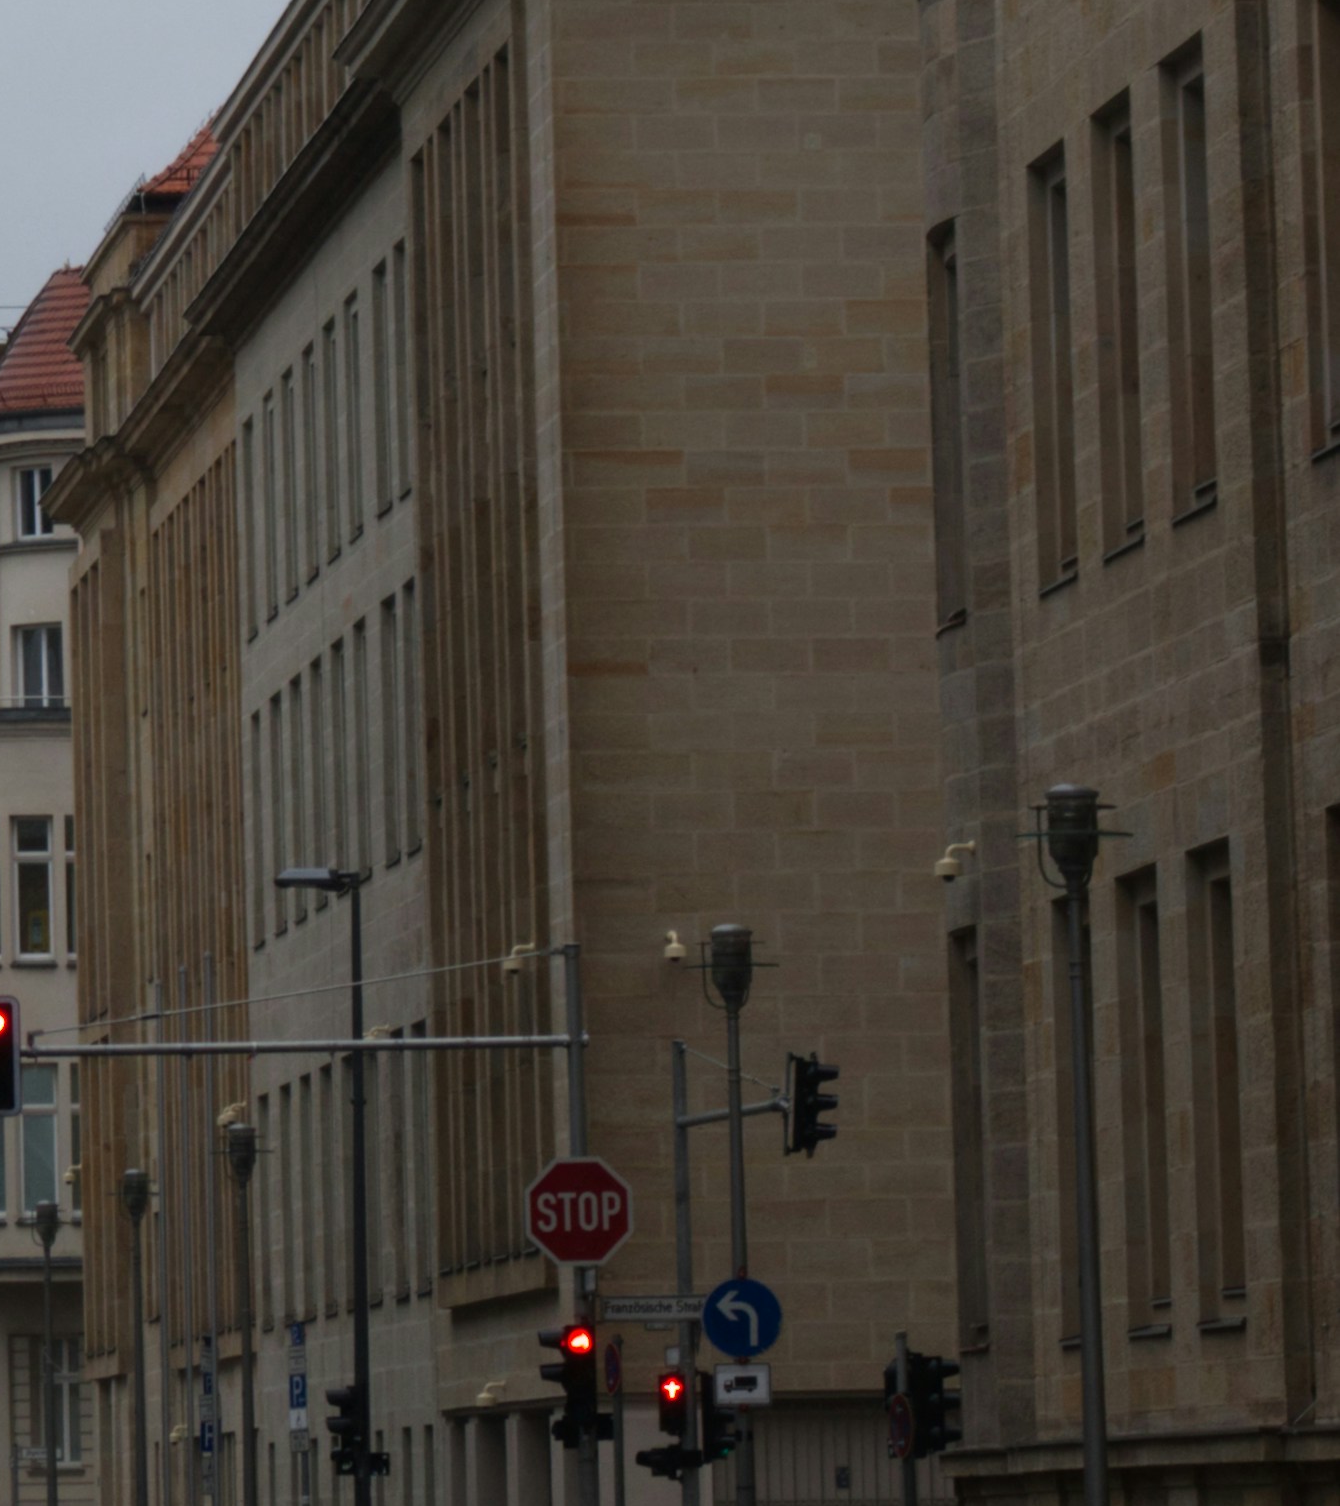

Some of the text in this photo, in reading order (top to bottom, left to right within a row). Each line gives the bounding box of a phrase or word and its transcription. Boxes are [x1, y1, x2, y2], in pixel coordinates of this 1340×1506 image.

[536, 1191, 621, 1233] STOP
[604, 1300, 672, 1314] Französische
[292, 1376, 303, 1407] P
